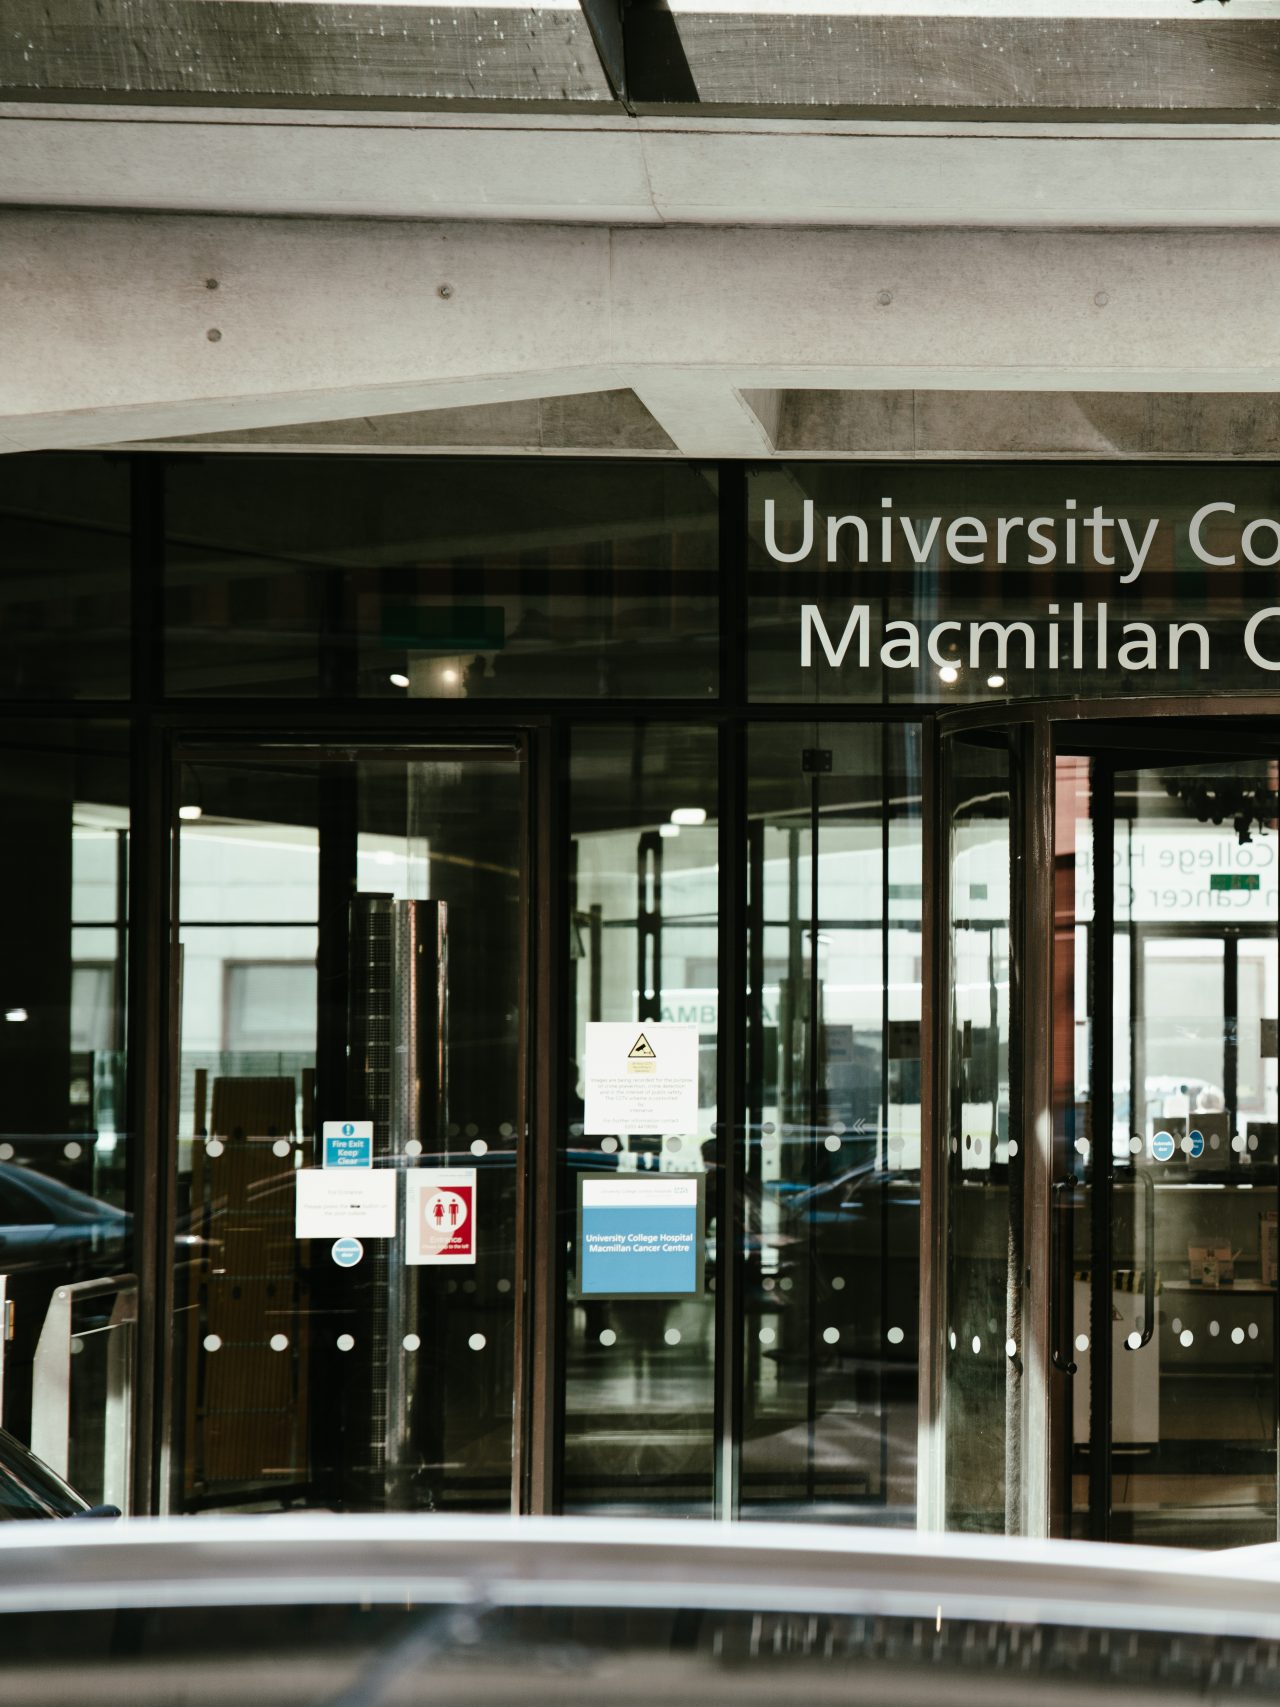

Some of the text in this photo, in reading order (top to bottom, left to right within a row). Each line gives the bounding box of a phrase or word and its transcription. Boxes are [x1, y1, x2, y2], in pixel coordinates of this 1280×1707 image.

[764, 497, 1160, 584] University
[800, 602, 1210, 671] Macmillan
[332, 1140, 364, 1148] Fire Exit
[338, 1149, 359, 1157] Keep
[337, 1157, 358, 1165] Clear
[586, 1233, 693, 1243] University College Hospital
[589, 1244, 690, 1252] Macmillan Cancer Centre
